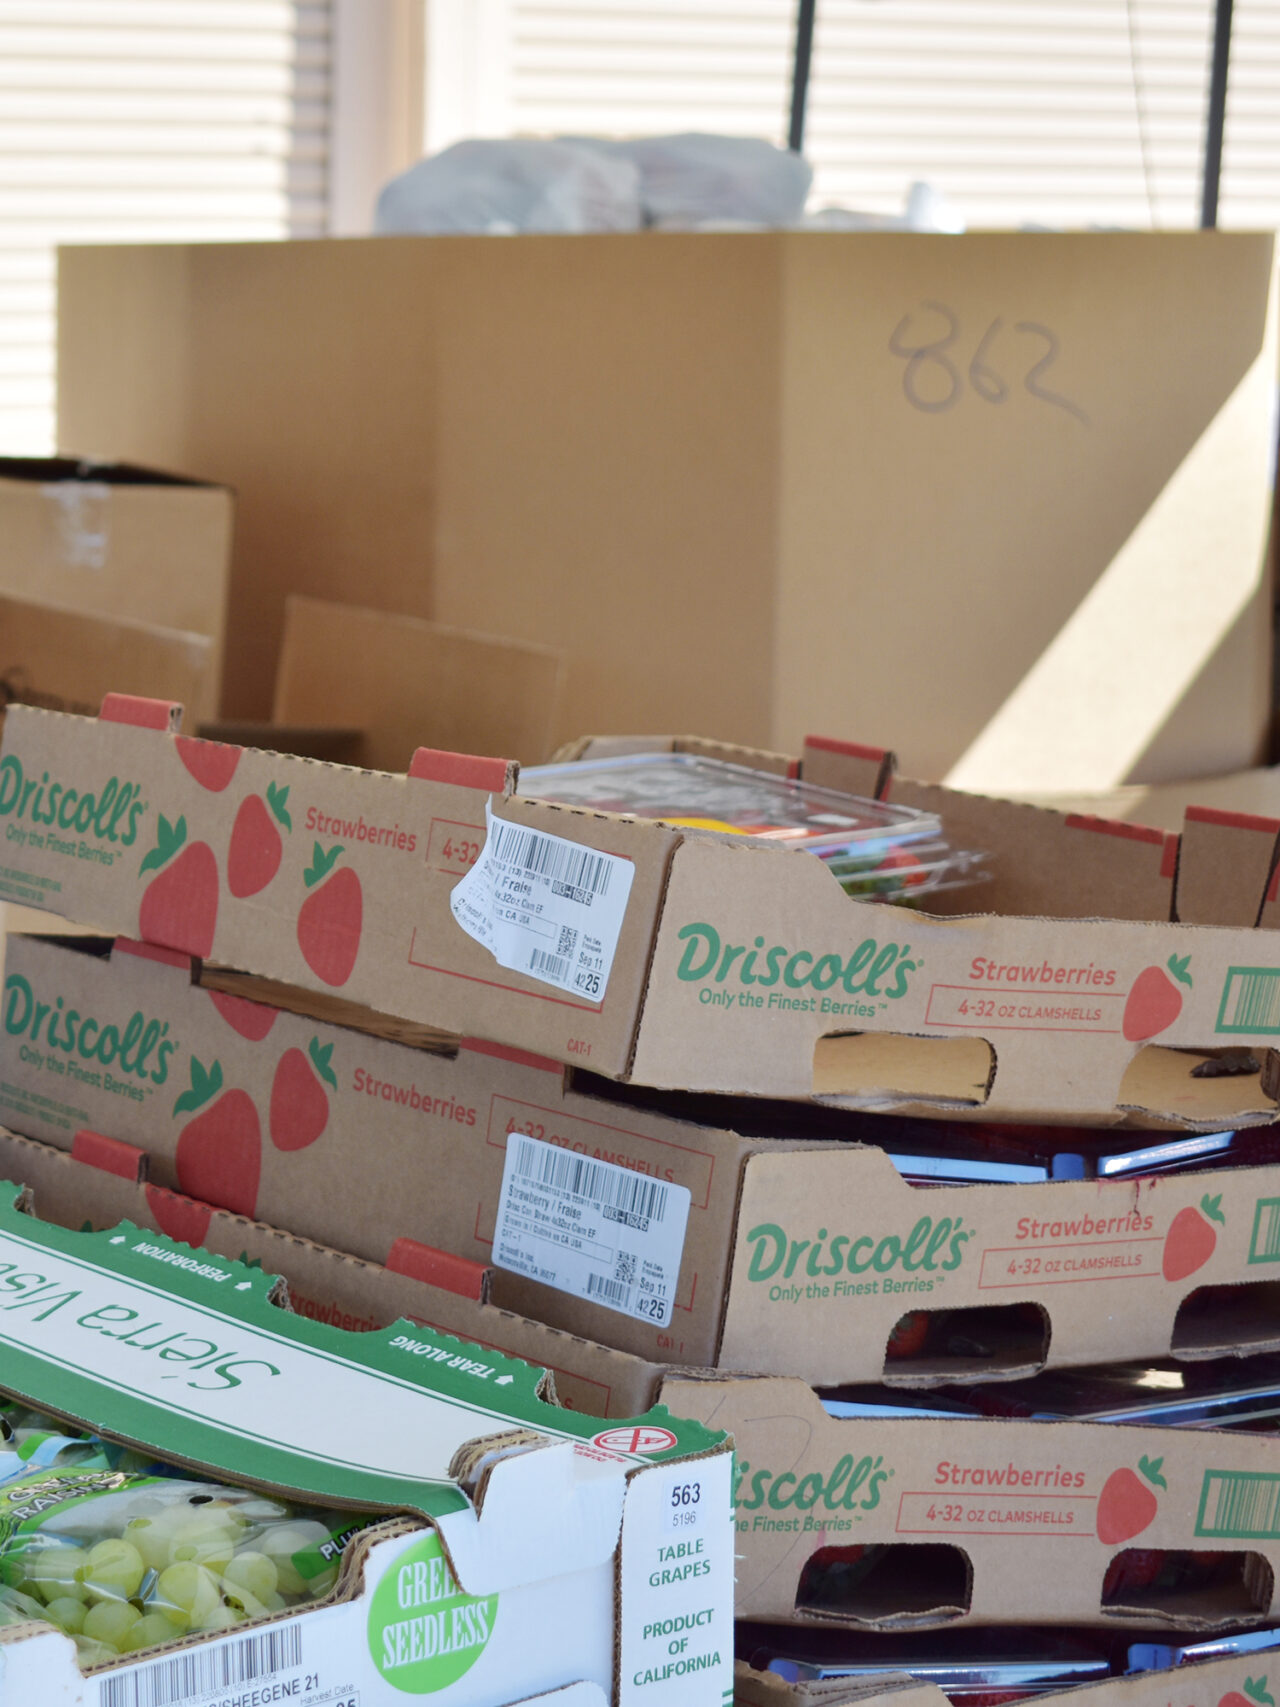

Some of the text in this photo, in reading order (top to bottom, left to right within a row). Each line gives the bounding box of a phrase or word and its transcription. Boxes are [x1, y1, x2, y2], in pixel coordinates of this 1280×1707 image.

[888, 299, 1091, 429] 862
[5, 823, 28, 844] Only
[28, 830, 45, 849] the
[46, 833, 76, 859] Finest
[305, 806, 417, 852] Strawberries
[442, 837, 479, 866] 4-32
[578, 952, 603, 970] Sep 11
[677, 922, 919, 999] Driscoll's
[969, 957, 1116, 986] Strawberries
[699, 988, 737, 1010] Only
[738, 989, 764, 1008] the
[768, 993, 816, 1013] Finest
[958, 999, 1102, 1022] 4-32 OZ CLAMSHELLS
[4, 973, 175, 1085] Driscoll's
[566, 1038, 593, 1057] CAT-1
[20, 1044, 43, 1071] Only
[45, 1050, 66, 1076] the
[67, 1060, 102, 1088] Finest
[353, 1068, 477, 1126] Strawberries
[1016, 1213, 1153, 1240] Strawberries
[132, 1242, 231, 1282] PERFORATION
[746, 1215, 971, 1282] Driscoll's
[1007, 1253, 1143, 1276] 4-32 OZ CLAMSHELLS
[639, 1277, 667, 1296] Sep 11
[768, 1283, 803, 1304] Only
[804, 1282, 830, 1299] the
[833, 1279, 879, 1298] Finest
[77, 1303, 281, 1391] Sierra
[388, 1335, 497, 1379] TEAR ALONG
[735, 1454, 891, 1511] iscoll's
[935, 1461, 1085, 1489] Strawberries
[671, 1482, 701, 1508] 563
[672, 1511, 697, 1527] 5196
[752, 1515, 800, 1532] Finest
[926, 1504, 1074, 1525] 4-32 OZ CLAMSHELLS
[657, 1538, 705, 1563] TABLE
[397, 1556, 459, 1610] GREE
[649, 1560, 712, 1588] GRAPES
[382, 1600, 489, 1671] SEEDLESS
[642, 1608, 715, 1640] PRODUCT
[667, 1637, 689, 1656] OF
[304, 1672, 320, 1692] 21
[632, 1651, 721, 1687] CALIFORNIA
